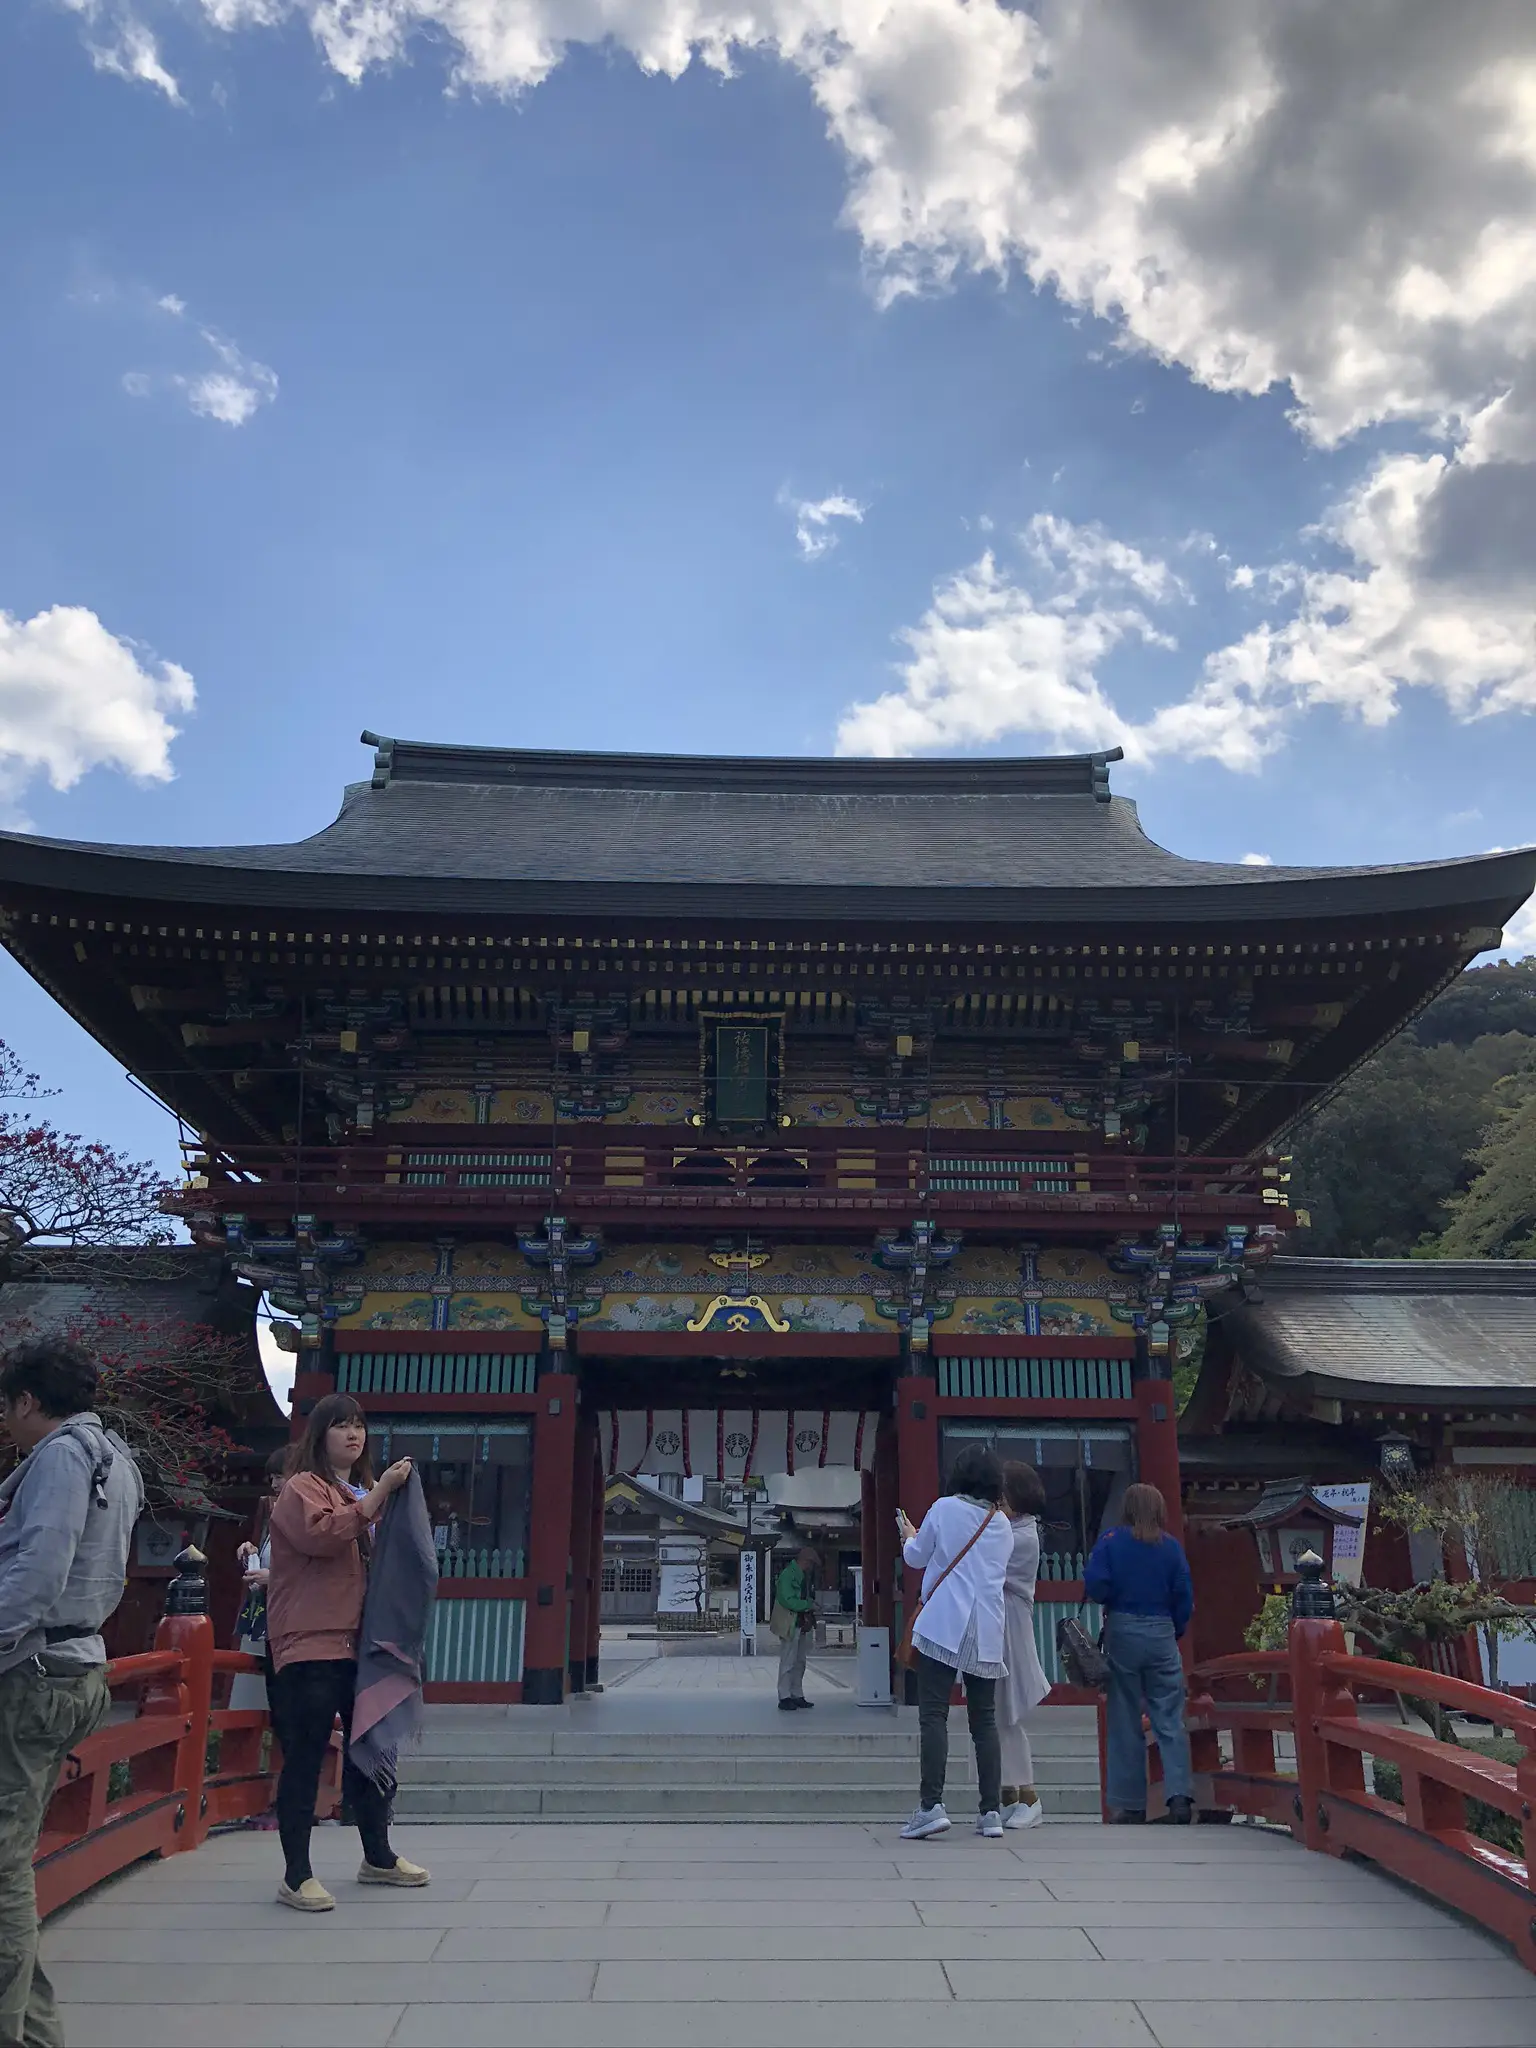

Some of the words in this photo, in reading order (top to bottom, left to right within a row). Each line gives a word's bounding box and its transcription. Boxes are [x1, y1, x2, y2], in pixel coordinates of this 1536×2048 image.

[744, 1553, 754, 1603] 御朱印受付
